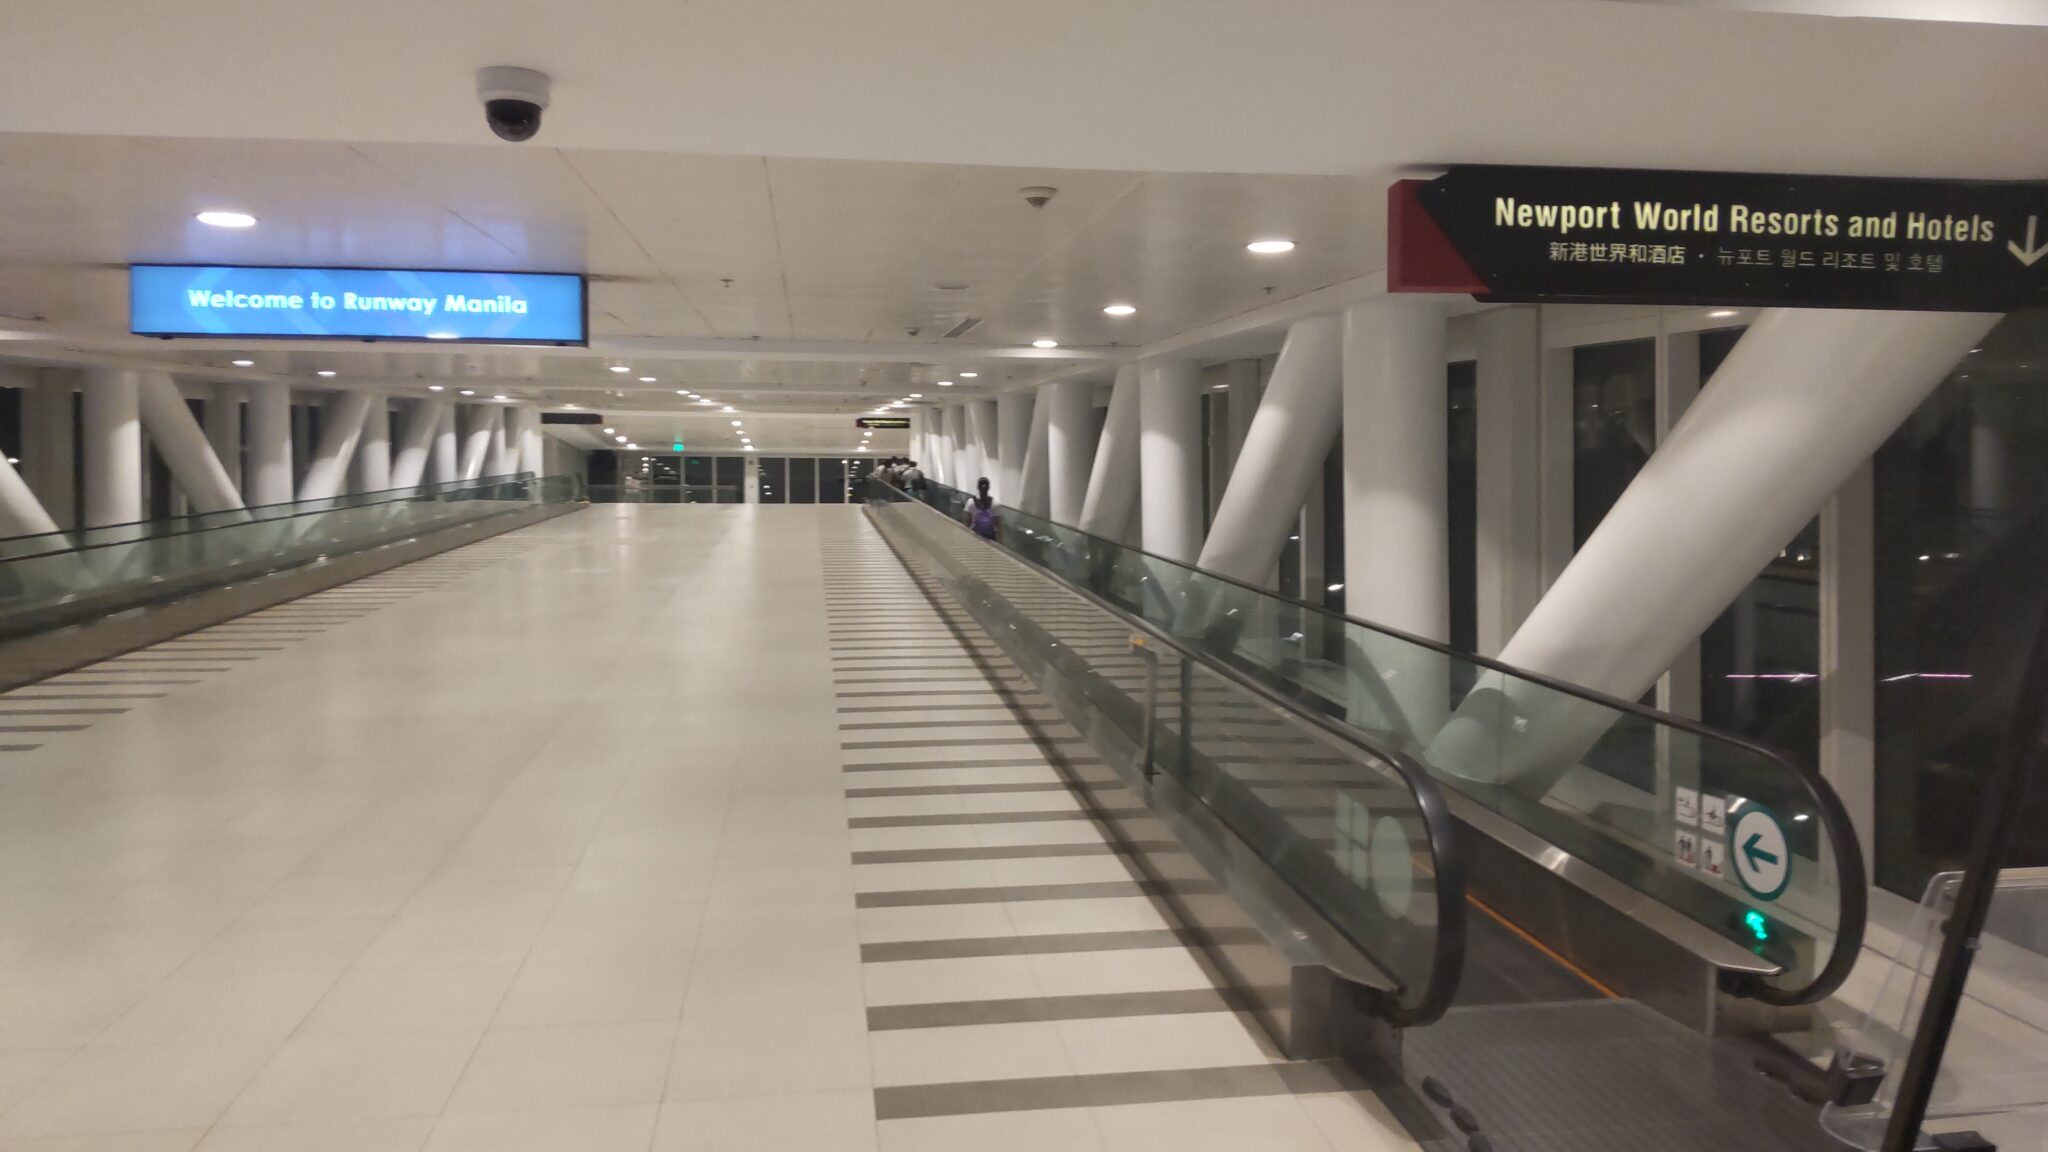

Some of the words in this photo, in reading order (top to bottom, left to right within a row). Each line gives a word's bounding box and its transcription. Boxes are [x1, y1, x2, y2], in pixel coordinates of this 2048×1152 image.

[1494, 196, 1621, 235] Newport
[1632, 201, 1719, 233] World
[1729, 204, 1839, 238] Resorts
[1848, 210, 1897, 240] and
[1907, 212, 1995, 243] Hotels
[1548, 241, 1686, 266] 新港世界和酒店
[1716, 246, 1773, 267] 뉴포트
[1779, 248, 1816, 269] 월드
[1821, 250, 1876, 270] 리조트
[1883, 252, 1902, 272] 및
[1907, 254, 1943, 273] 호텔
[187, 288, 303, 310] Welcome
[309, 291, 337, 311] to
[342, 291, 438, 316] Runway
[443, 294, 528, 316] Manila
